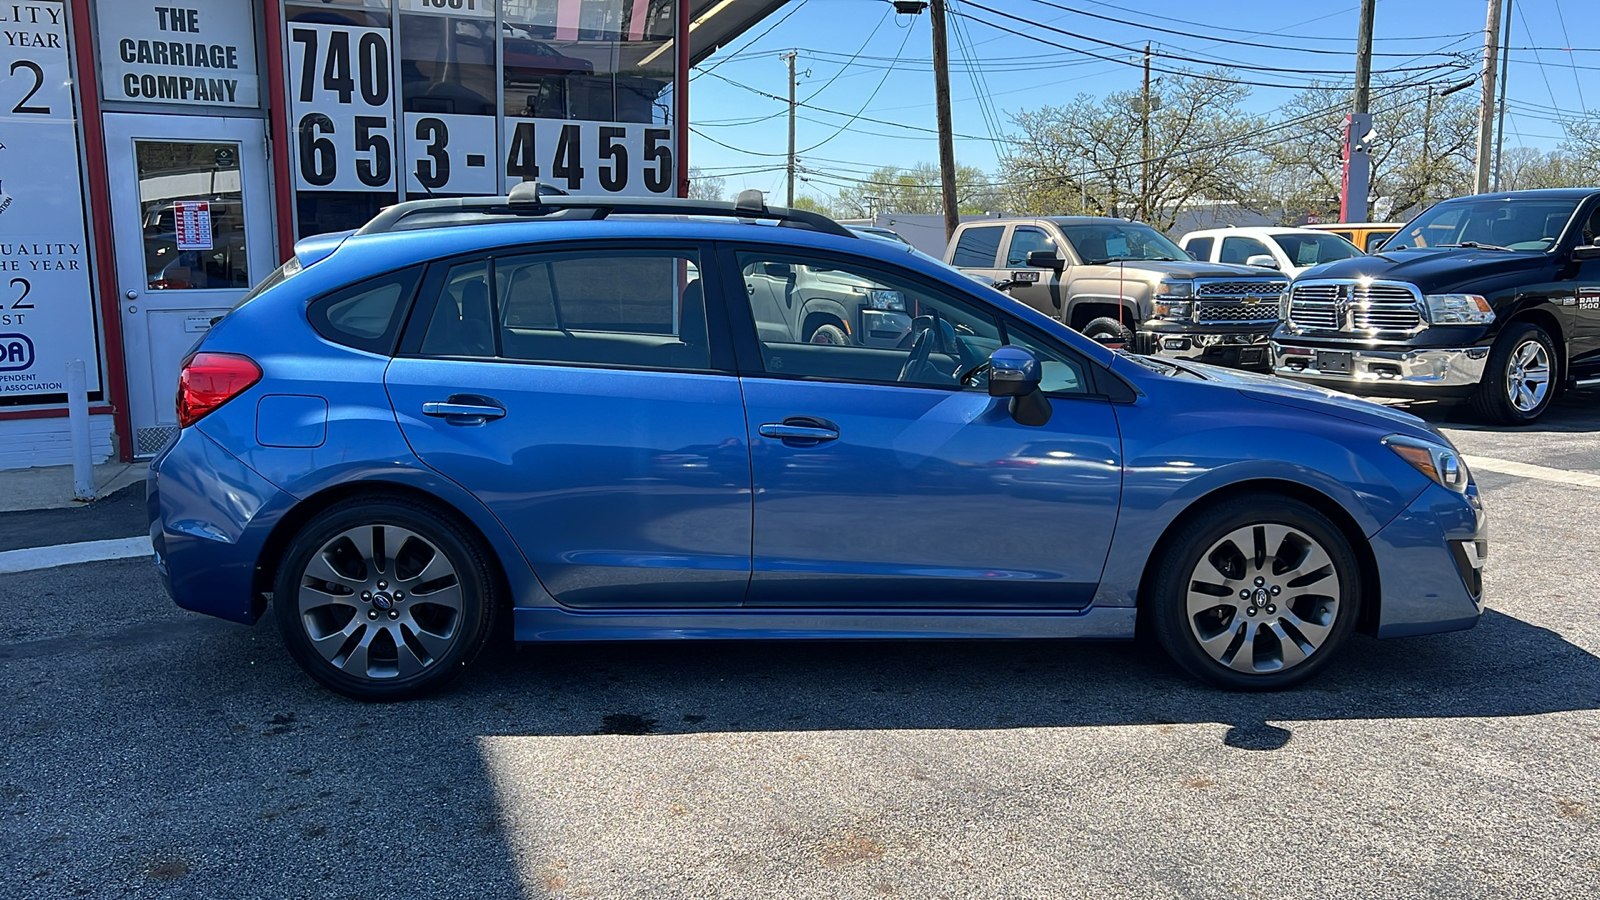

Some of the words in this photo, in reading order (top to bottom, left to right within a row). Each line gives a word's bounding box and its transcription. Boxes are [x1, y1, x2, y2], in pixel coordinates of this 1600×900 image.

[154, 6, 200, 34] THE
[4, 30, 62, 49] YEAR
[119, 38, 239, 69] CARRIAGE
[292, 27, 390, 107] 740
[123, 73, 238, 102] COMPANY
[29, 259, 80, 271] YEAR
[4, 382, 63, 392] ASSOCIATION
